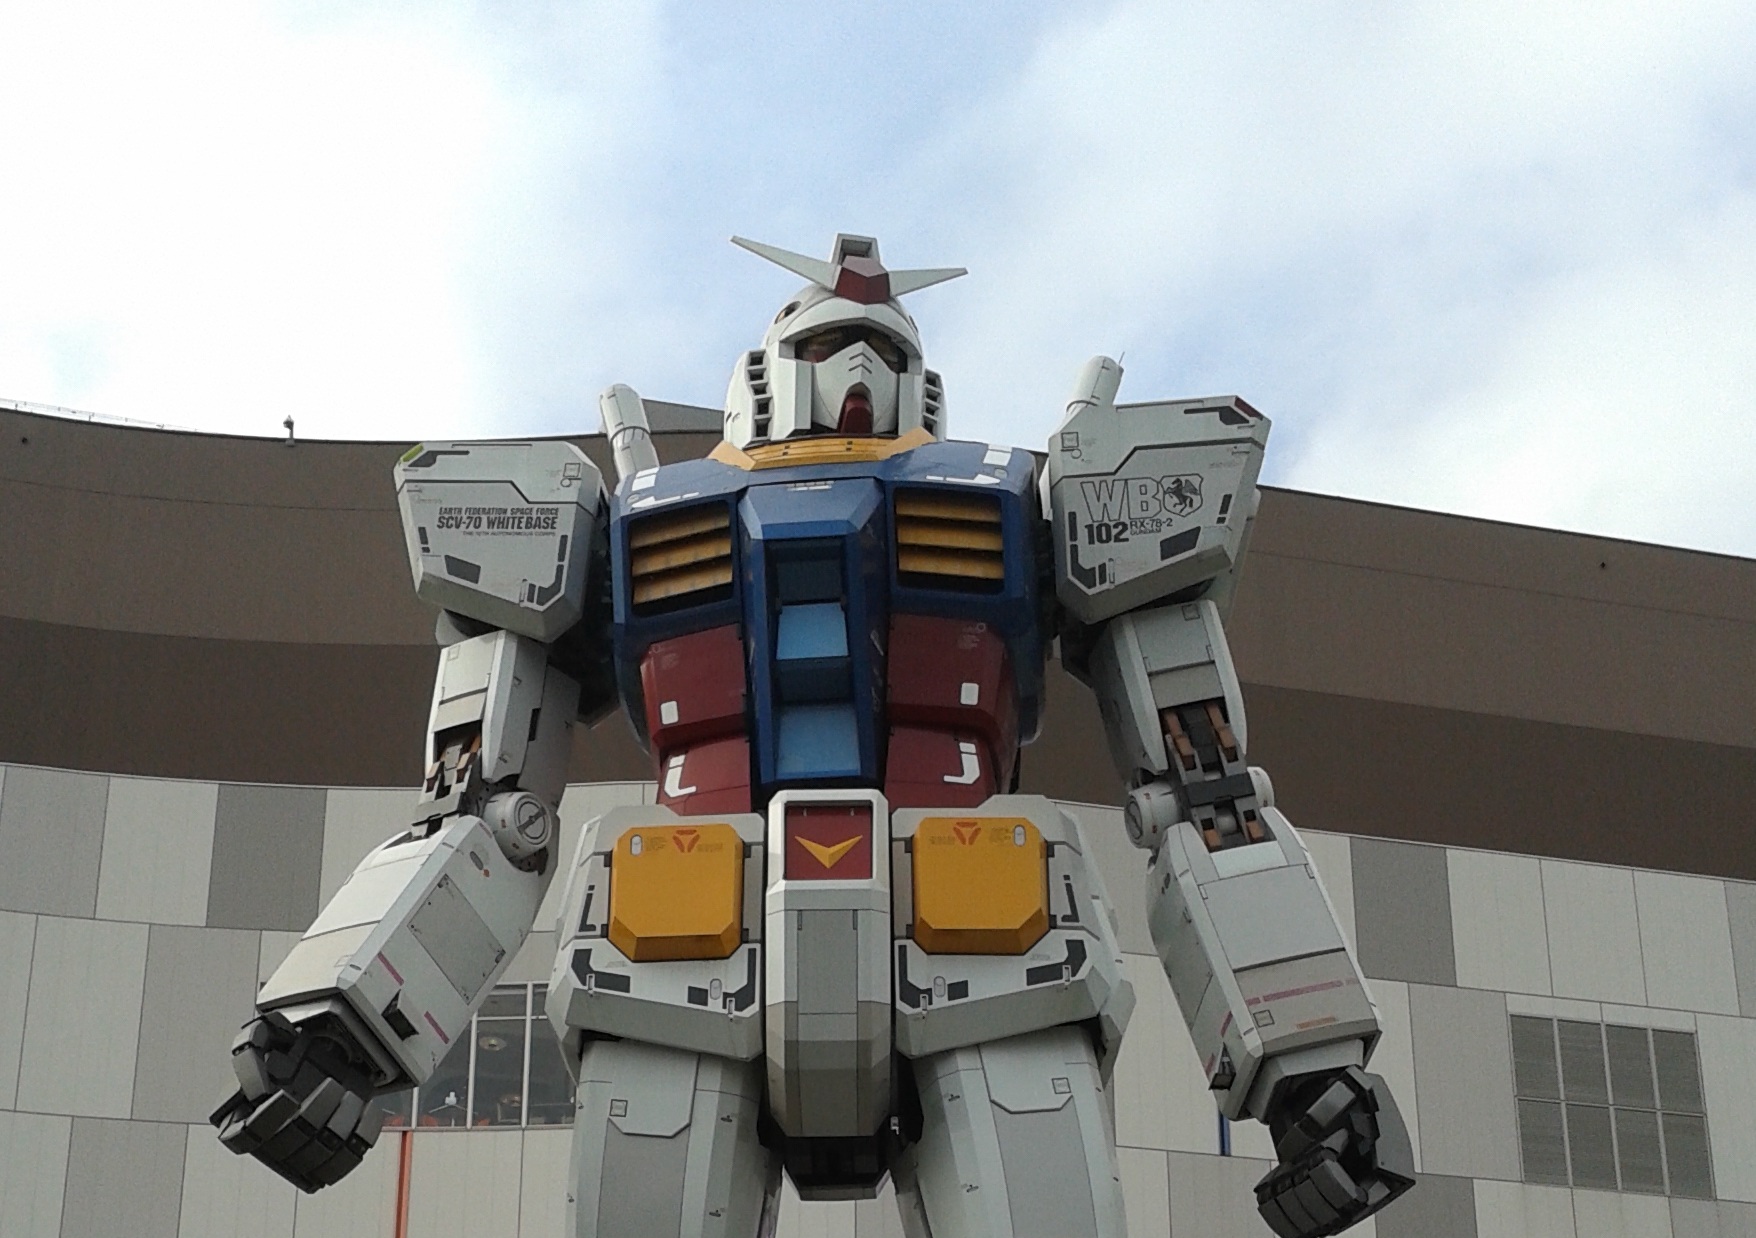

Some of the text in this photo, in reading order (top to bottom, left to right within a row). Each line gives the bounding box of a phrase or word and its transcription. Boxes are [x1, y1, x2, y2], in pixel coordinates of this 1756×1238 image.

[1080, 477, 1162, 522] WB
[438, 506, 559, 516] EARTH FEDERATION SPACE FORCE
[437, 515, 482, 529] SCV-70
[1085, 521, 1130, 545] 102
